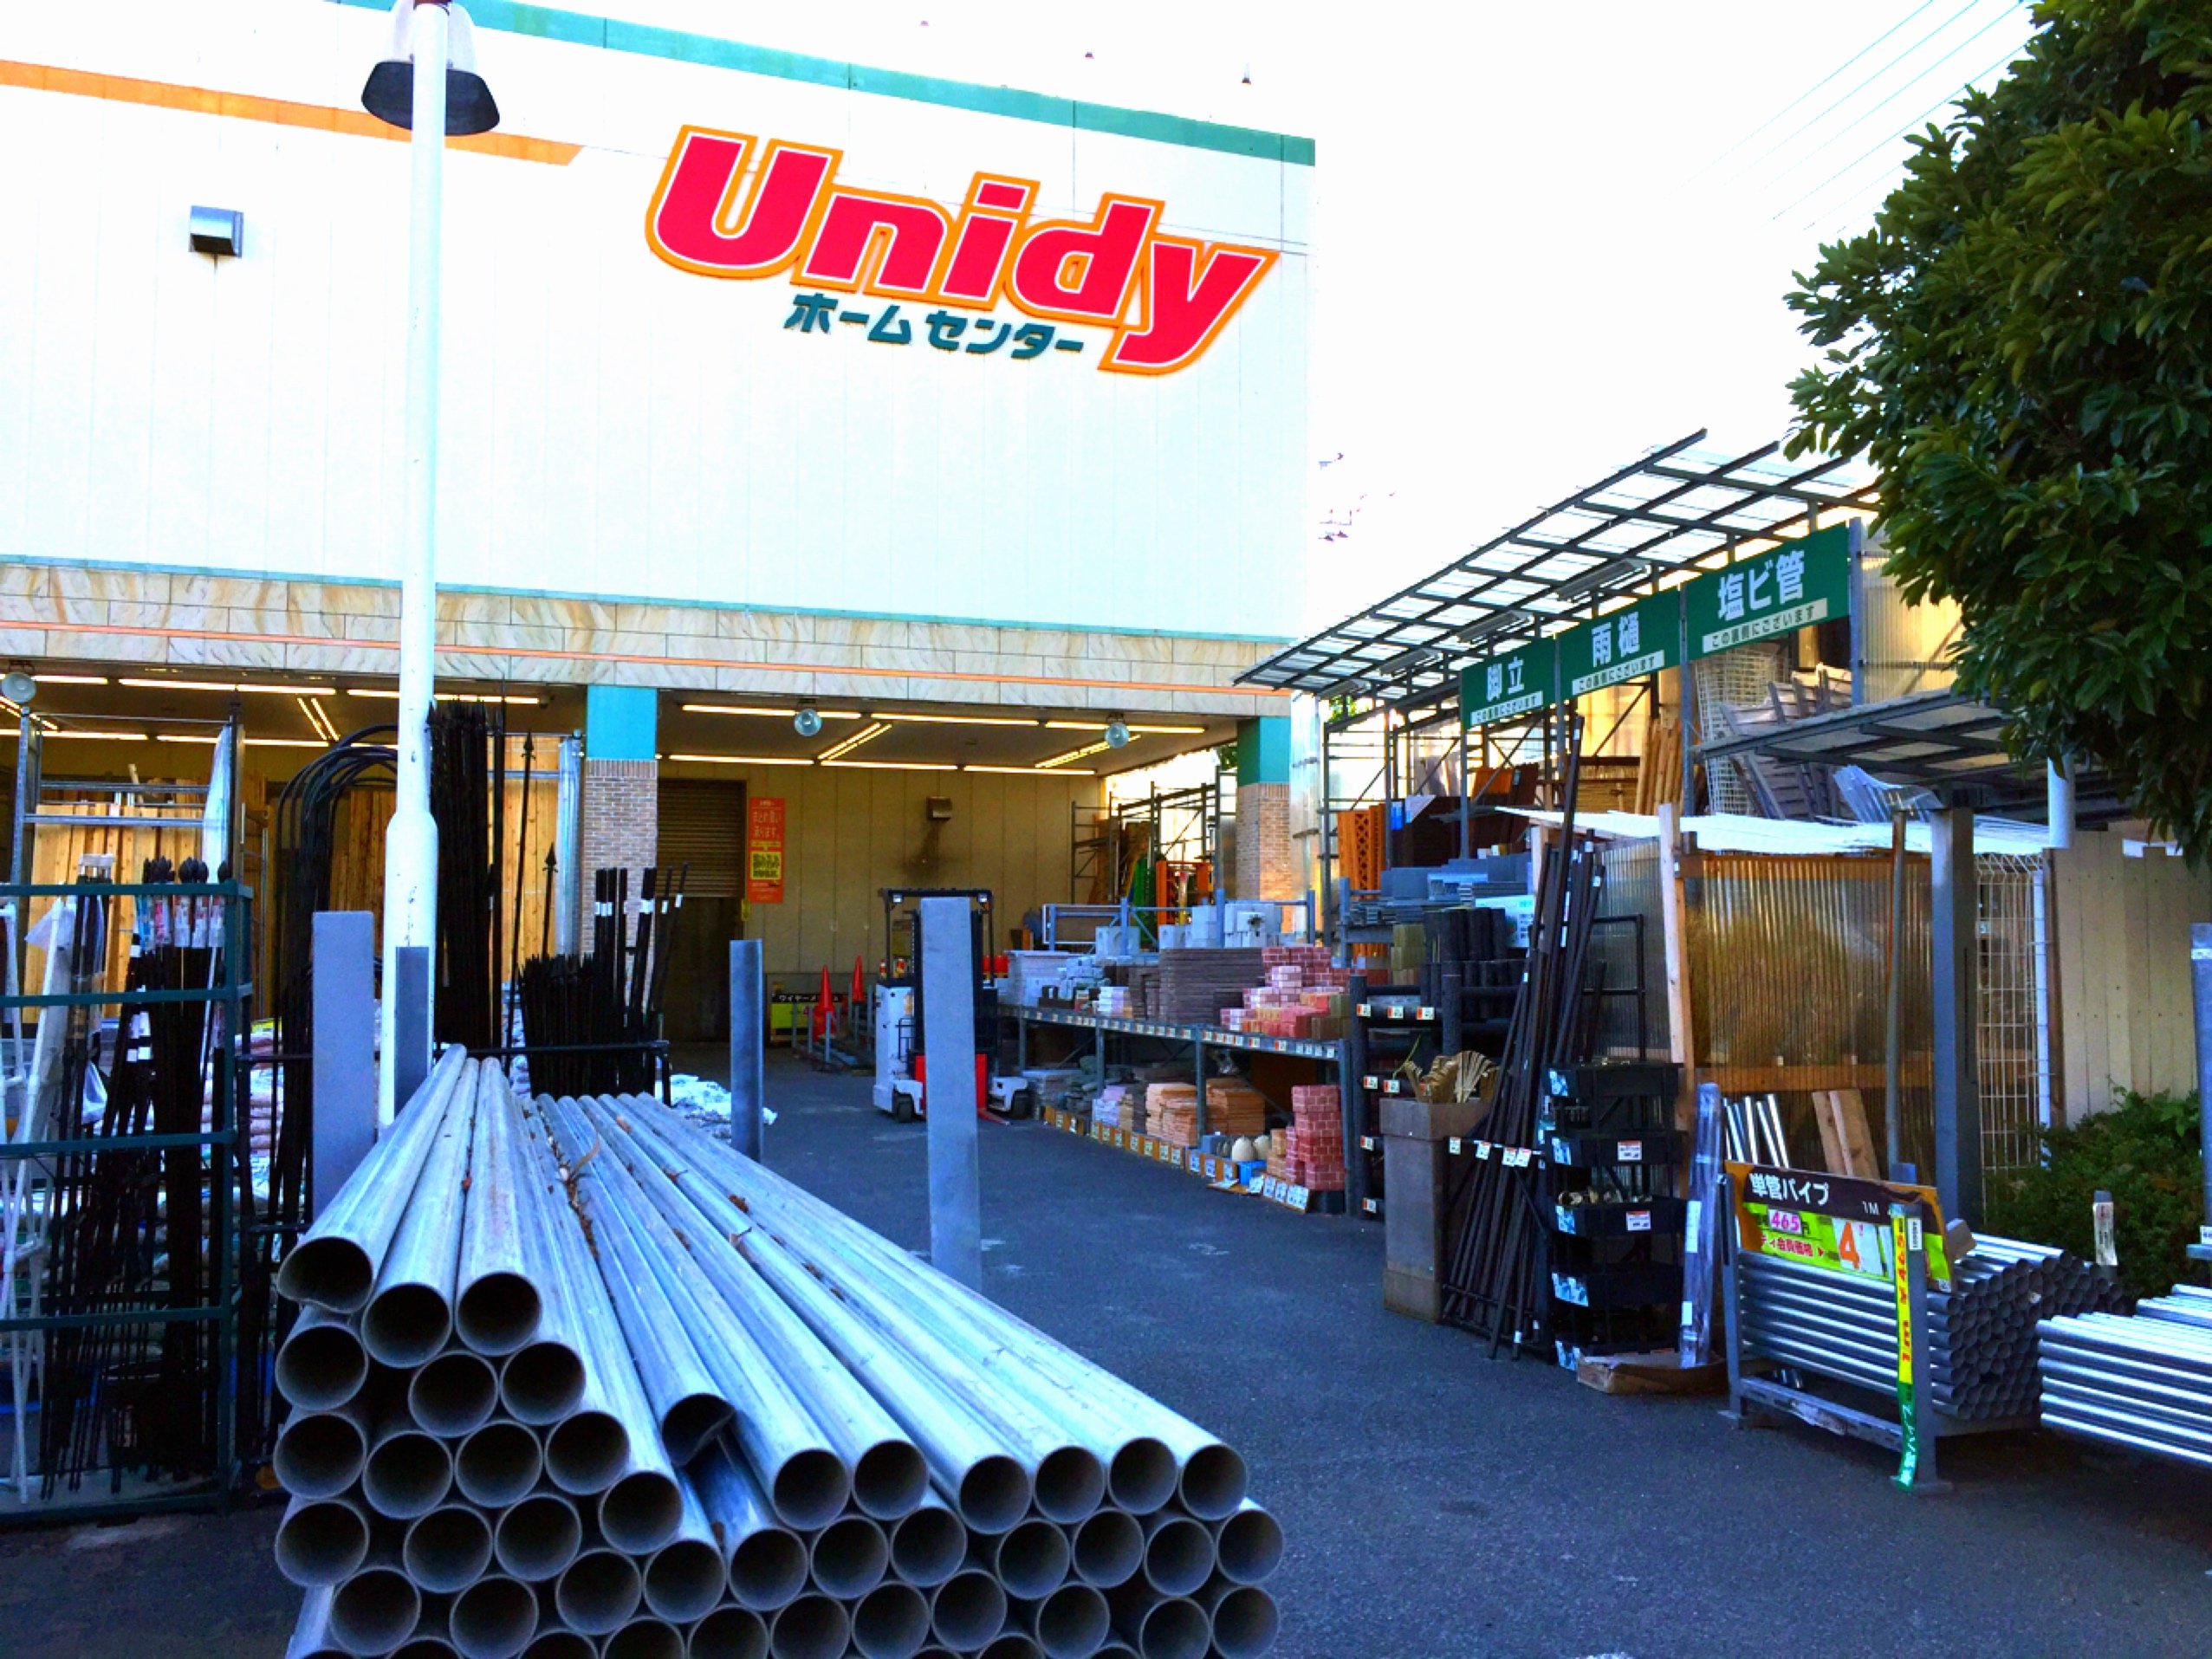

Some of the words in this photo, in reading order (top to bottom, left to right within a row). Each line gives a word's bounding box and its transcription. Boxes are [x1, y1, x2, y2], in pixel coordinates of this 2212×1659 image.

[645, 125, 1281, 376] Unidy
[783, 292, 1085, 360] ホームセンター
[1718, 549, 1805, 621] 塩ビ管
[1748, 1173, 1829, 1206] 単管パイプ
